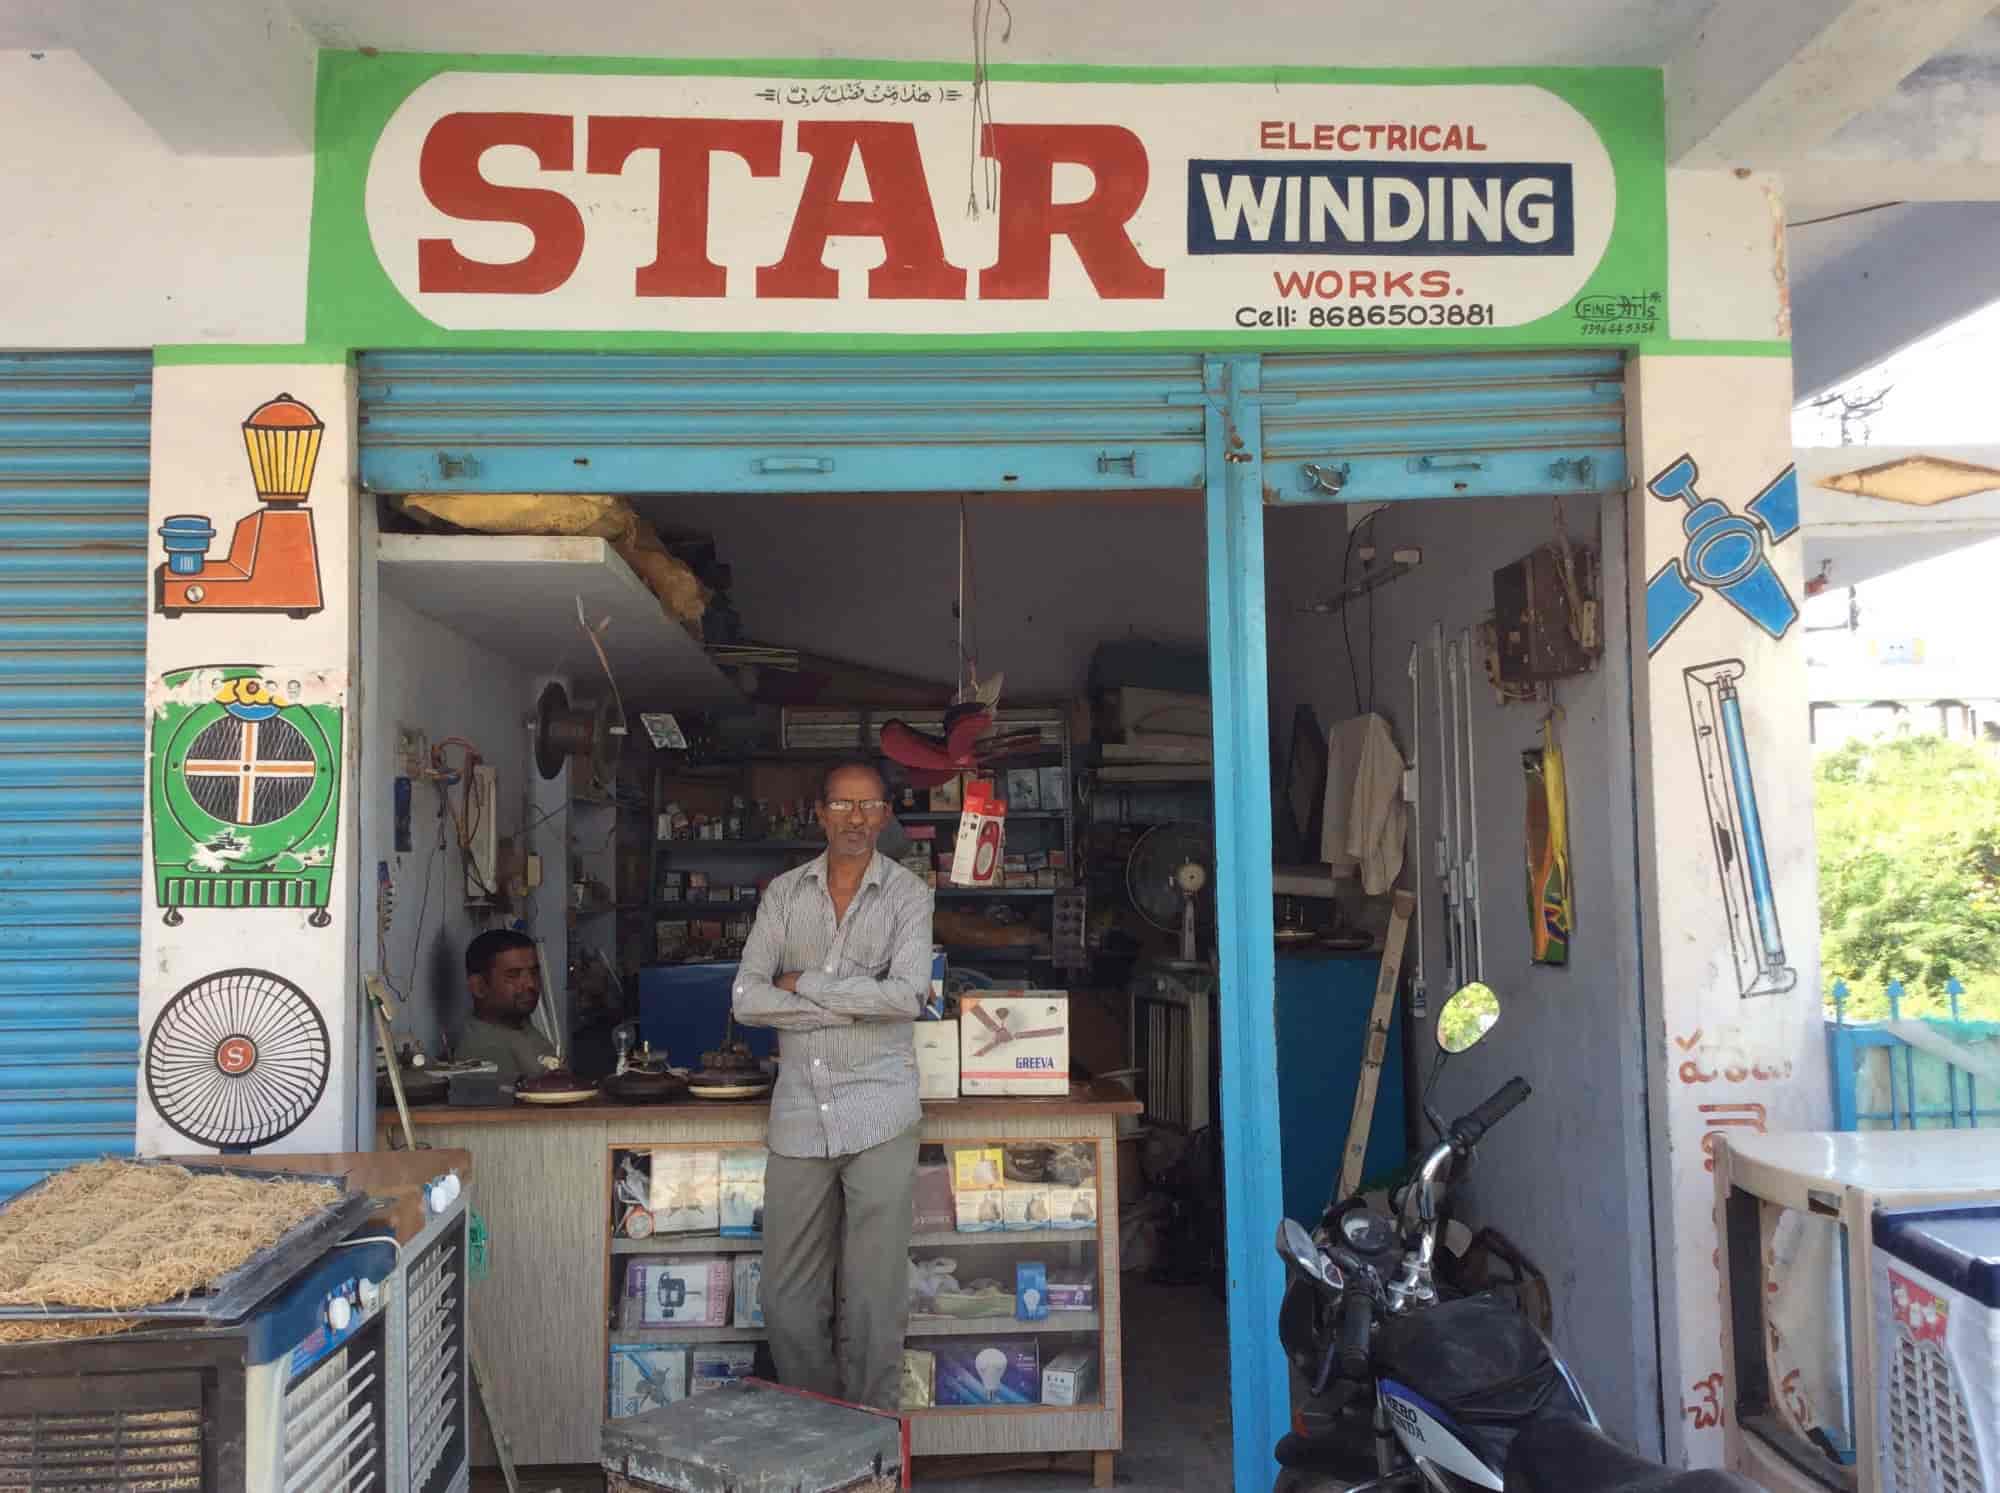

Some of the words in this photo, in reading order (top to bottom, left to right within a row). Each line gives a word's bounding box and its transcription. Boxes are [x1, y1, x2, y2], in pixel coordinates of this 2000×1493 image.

[1259, 121, 1487, 152] ELECTRICAL
[418, 112, 1165, 300] STAR
[1200, 172, 1555, 244] WINDING
[1273, 269, 1464, 299] WORKS.
[1235, 305, 1297, 328] Cell:
[1309, 304, 1494, 328] 8686503881
[1583, 303, 1616, 316] FINE
[226, 1047, 244, 1067] S
[1015, 1056, 1055, 1069] GREEVA
